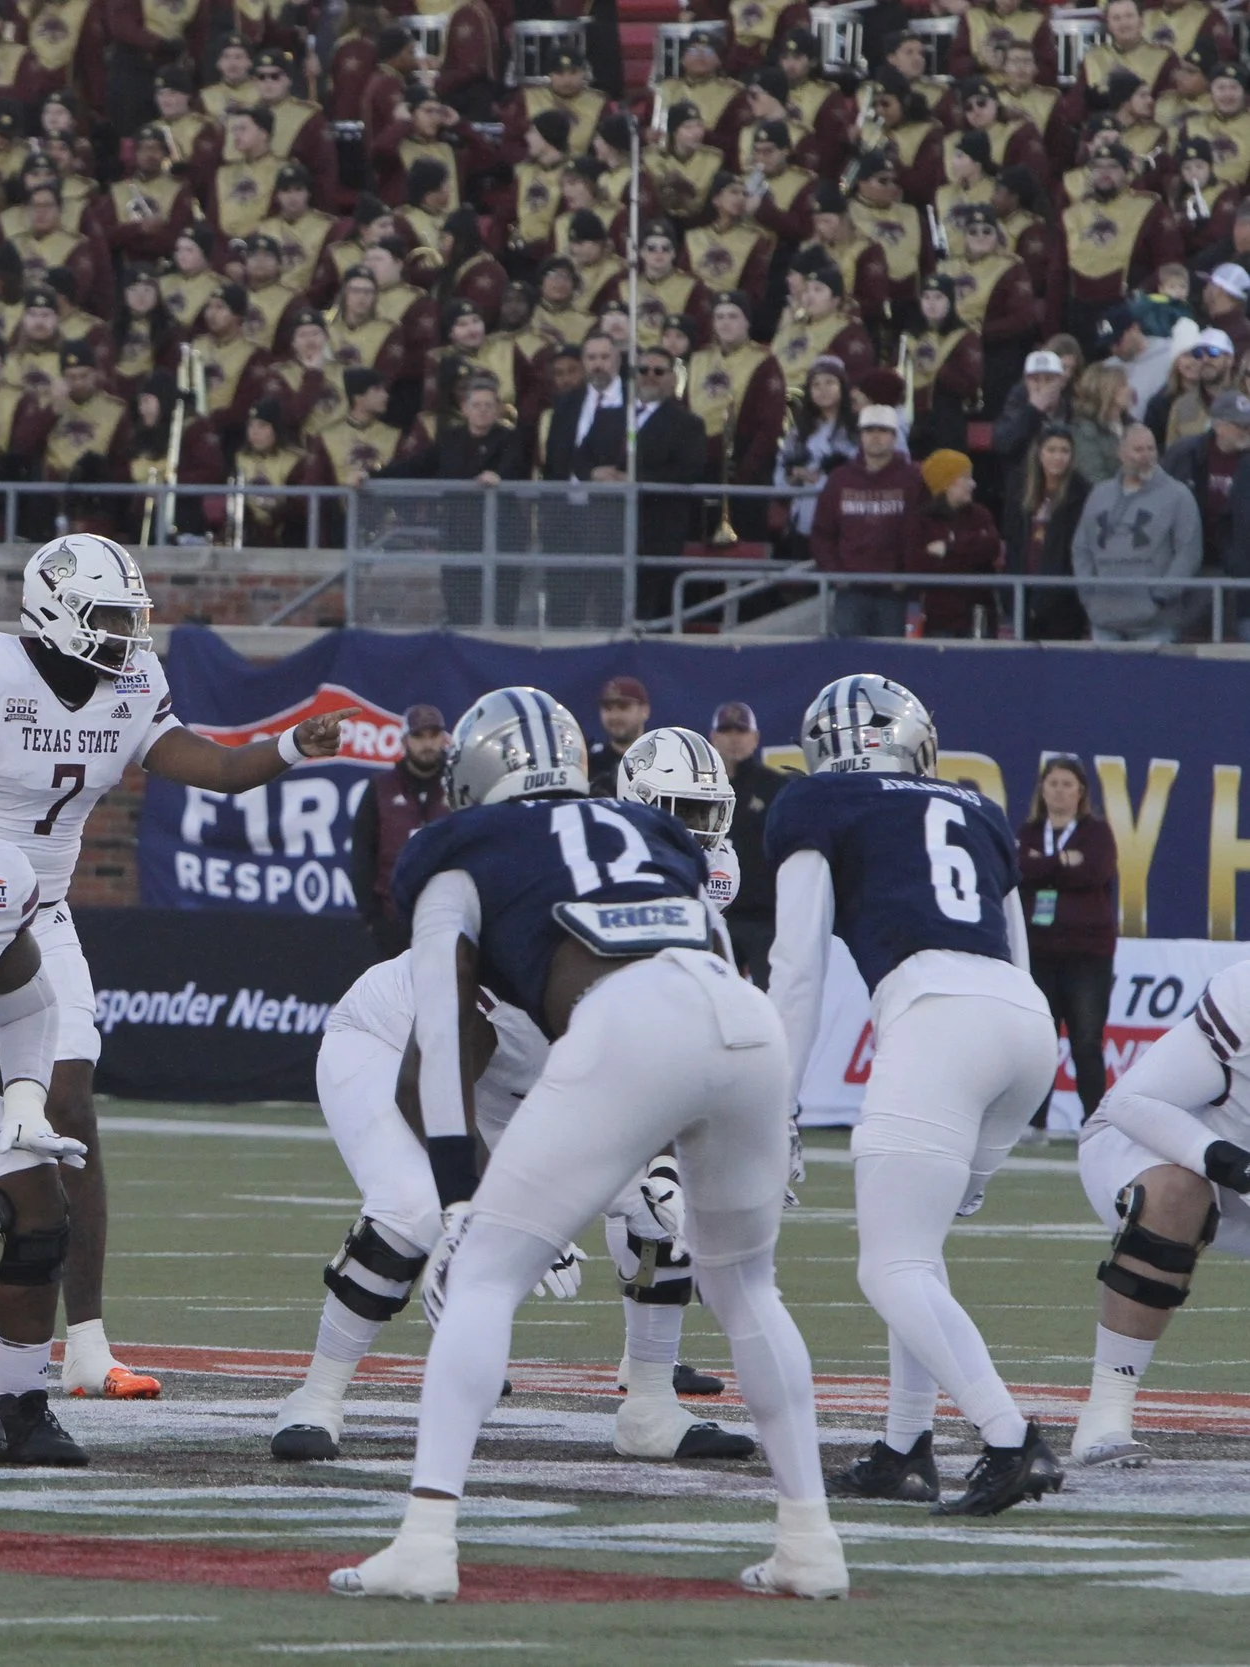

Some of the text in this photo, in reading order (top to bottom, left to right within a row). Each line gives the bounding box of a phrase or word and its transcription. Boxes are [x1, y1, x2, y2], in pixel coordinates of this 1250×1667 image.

[6, 698, 38, 714] SBC
[22, 727, 120, 753] TEXAS STATE
[524, 771, 567, 791] OWLS
[34, 764, 86, 835] 7
[550, 803, 666, 897] 12
[925, 797, 982, 924] 6
[596, 905, 690, 929] RICE
[1125, 975, 1184, 1019] TO
